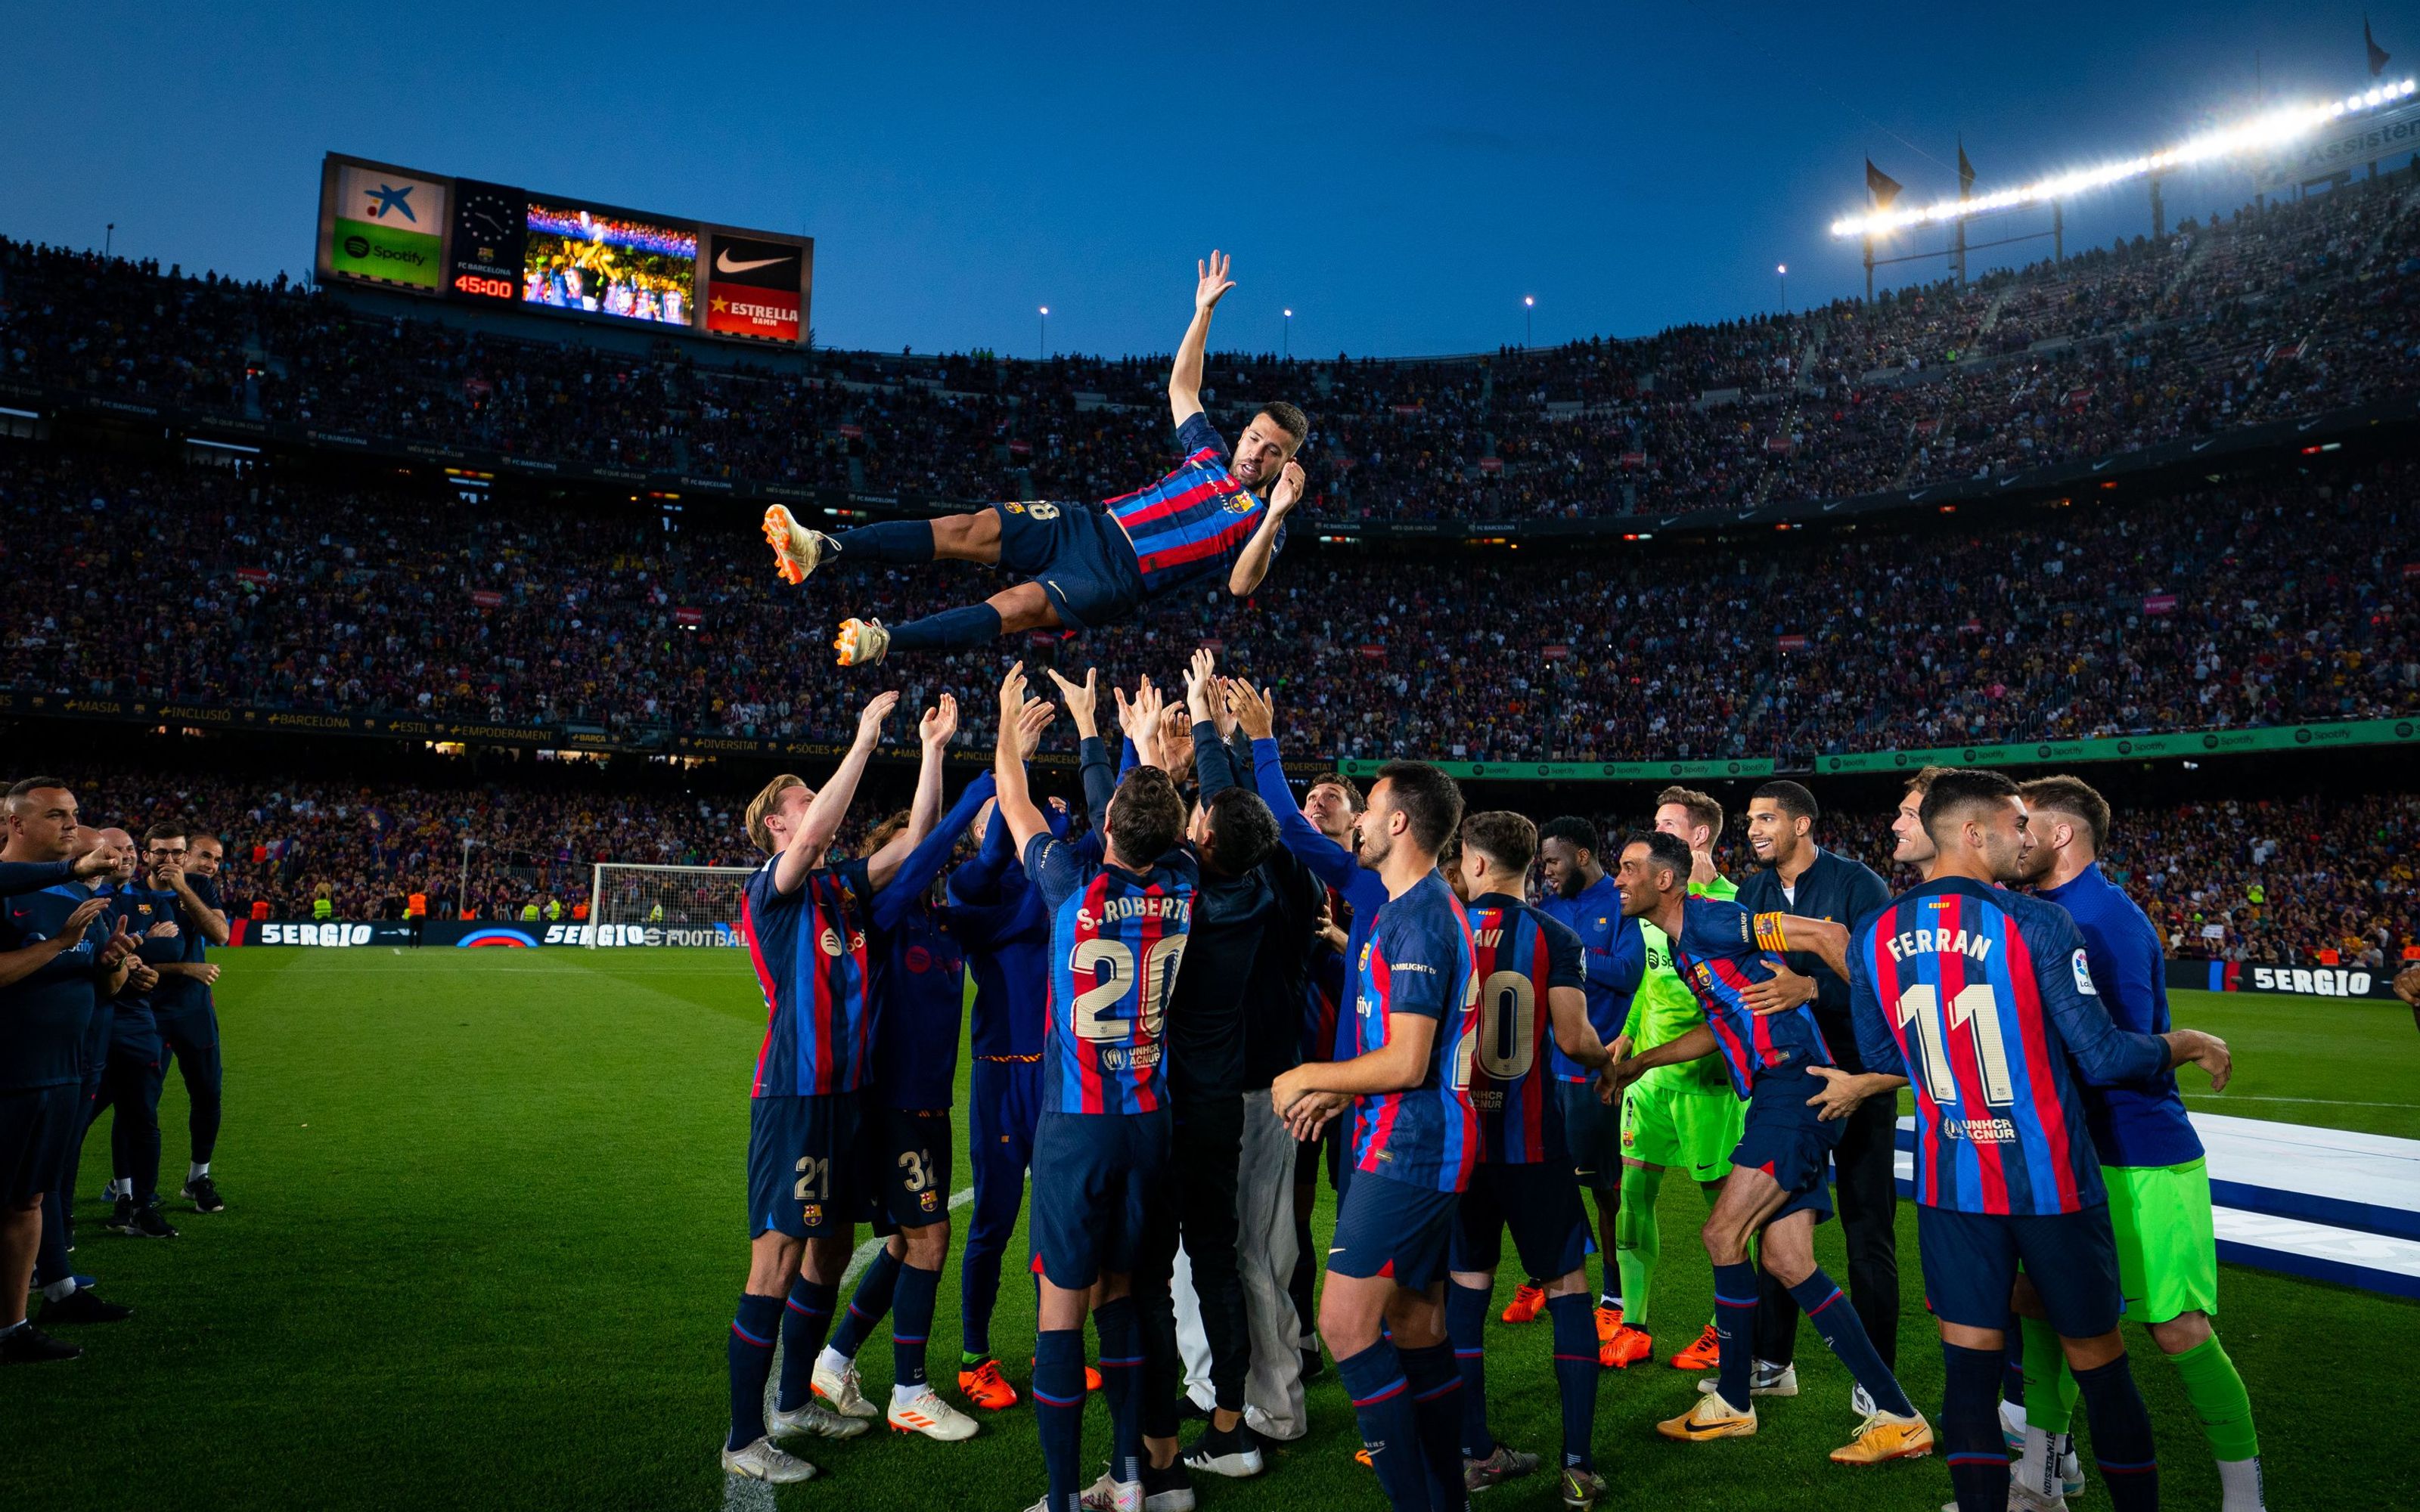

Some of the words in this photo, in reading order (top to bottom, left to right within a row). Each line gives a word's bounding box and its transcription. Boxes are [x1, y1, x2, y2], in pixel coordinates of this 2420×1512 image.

[373, 246, 425, 266] Spotify
[467, 263, 510, 276] BARCELONA
[455, 276, 512, 299] 45:00
[731, 302, 798, 322] ESTRELLA
[752, 317, 777, 327] DAMM
[2221, 736, 2254, 746] Spotify
[2314, 730, 2351, 740] Spotify
[1473, 928, 1505, 948] AVI
[1885, 928, 1992, 962] FERRAN
[1069, 934, 1187, 1043] 20
[1356, 995, 1373, 1018] tify
[1476, 971, 1535, 1080] 0
[1128, 1043, 1160, 1056] UNHCR
[1895, 984, 2014, 1107] 11
[1472, 1089, 1503, 1100] NHCR
[1474, 1098, 1502, 1109] CNUR
[1961, 1118, 2012, 1130] UNHCR
[1966, 1128, 2015, 1140] ACNUR
[794, 1156, 829, 1201] 21
